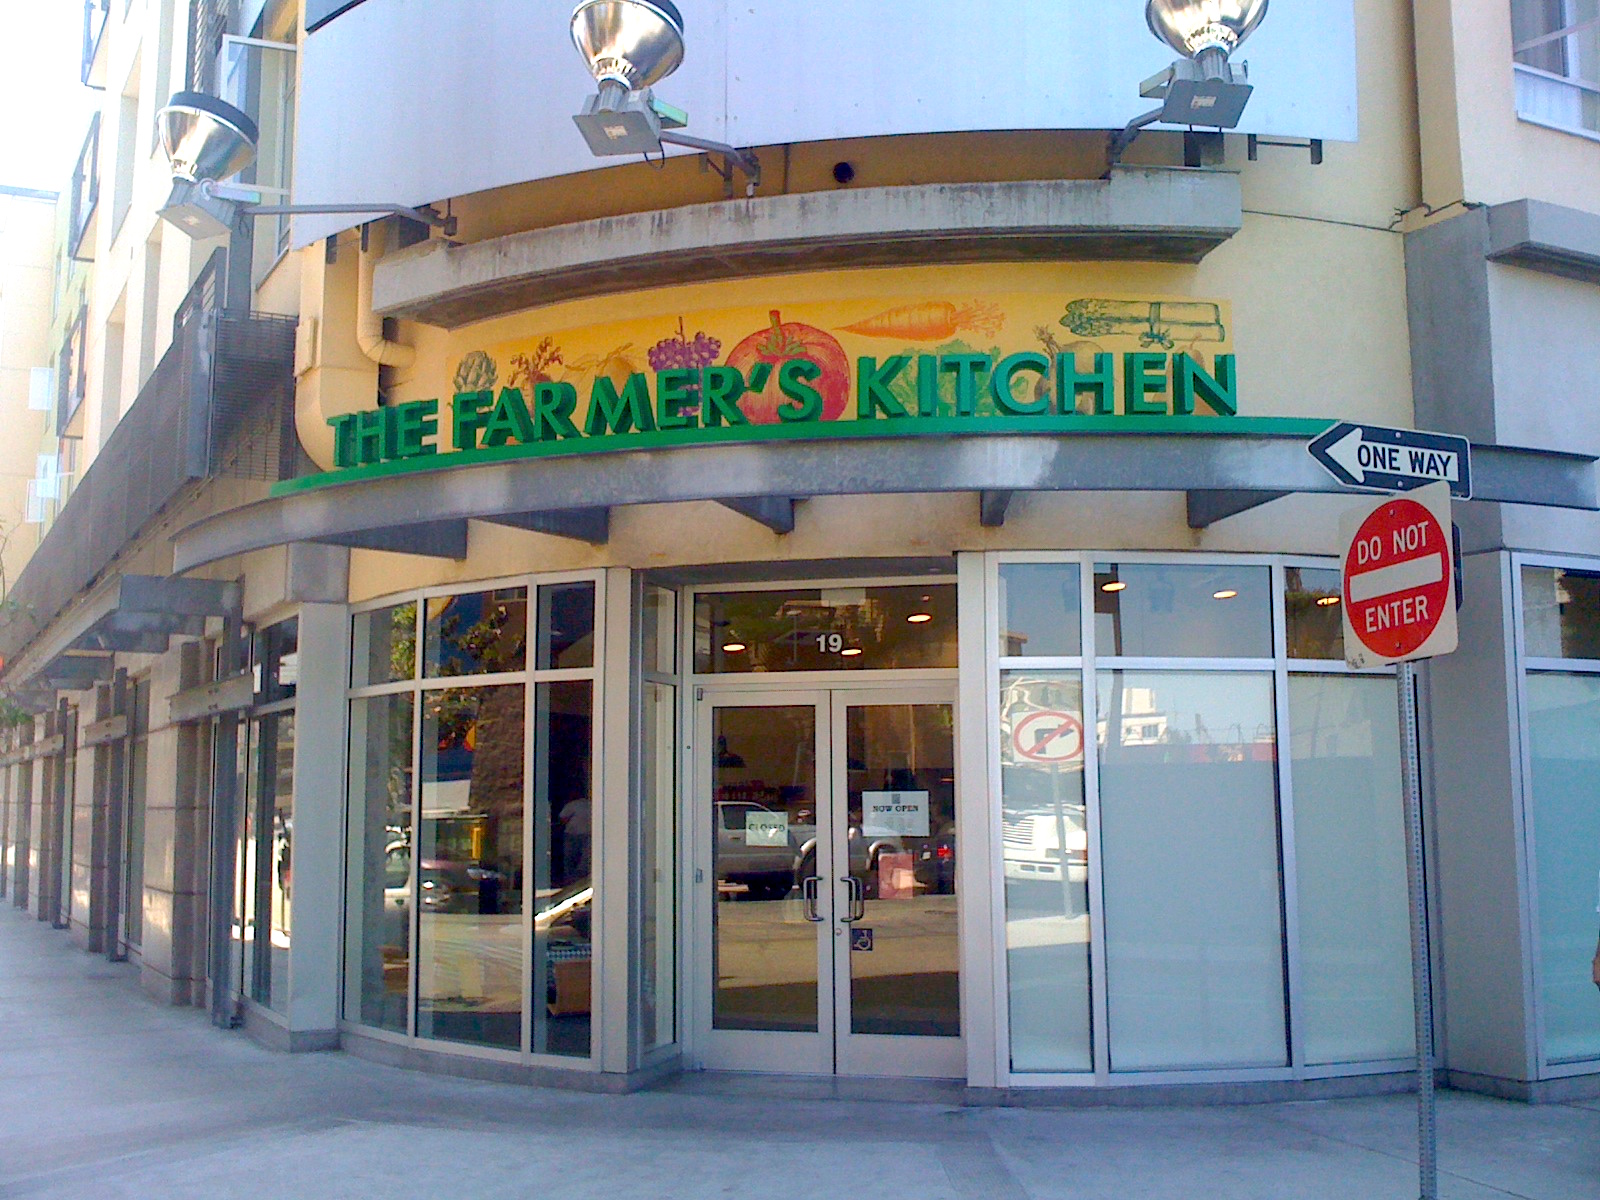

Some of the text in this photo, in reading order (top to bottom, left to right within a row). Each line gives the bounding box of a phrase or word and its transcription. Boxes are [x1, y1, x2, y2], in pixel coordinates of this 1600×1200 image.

[328, 351, 1237, 468] THE FARMER'S KITCHEN
[1357, 444, 1452, 477] ONE WAY
[1357, 520, 1429, 565] DO NOT
[1365, 596, 1429, 633] ENTER
[815, 633, 843, 653] 19
